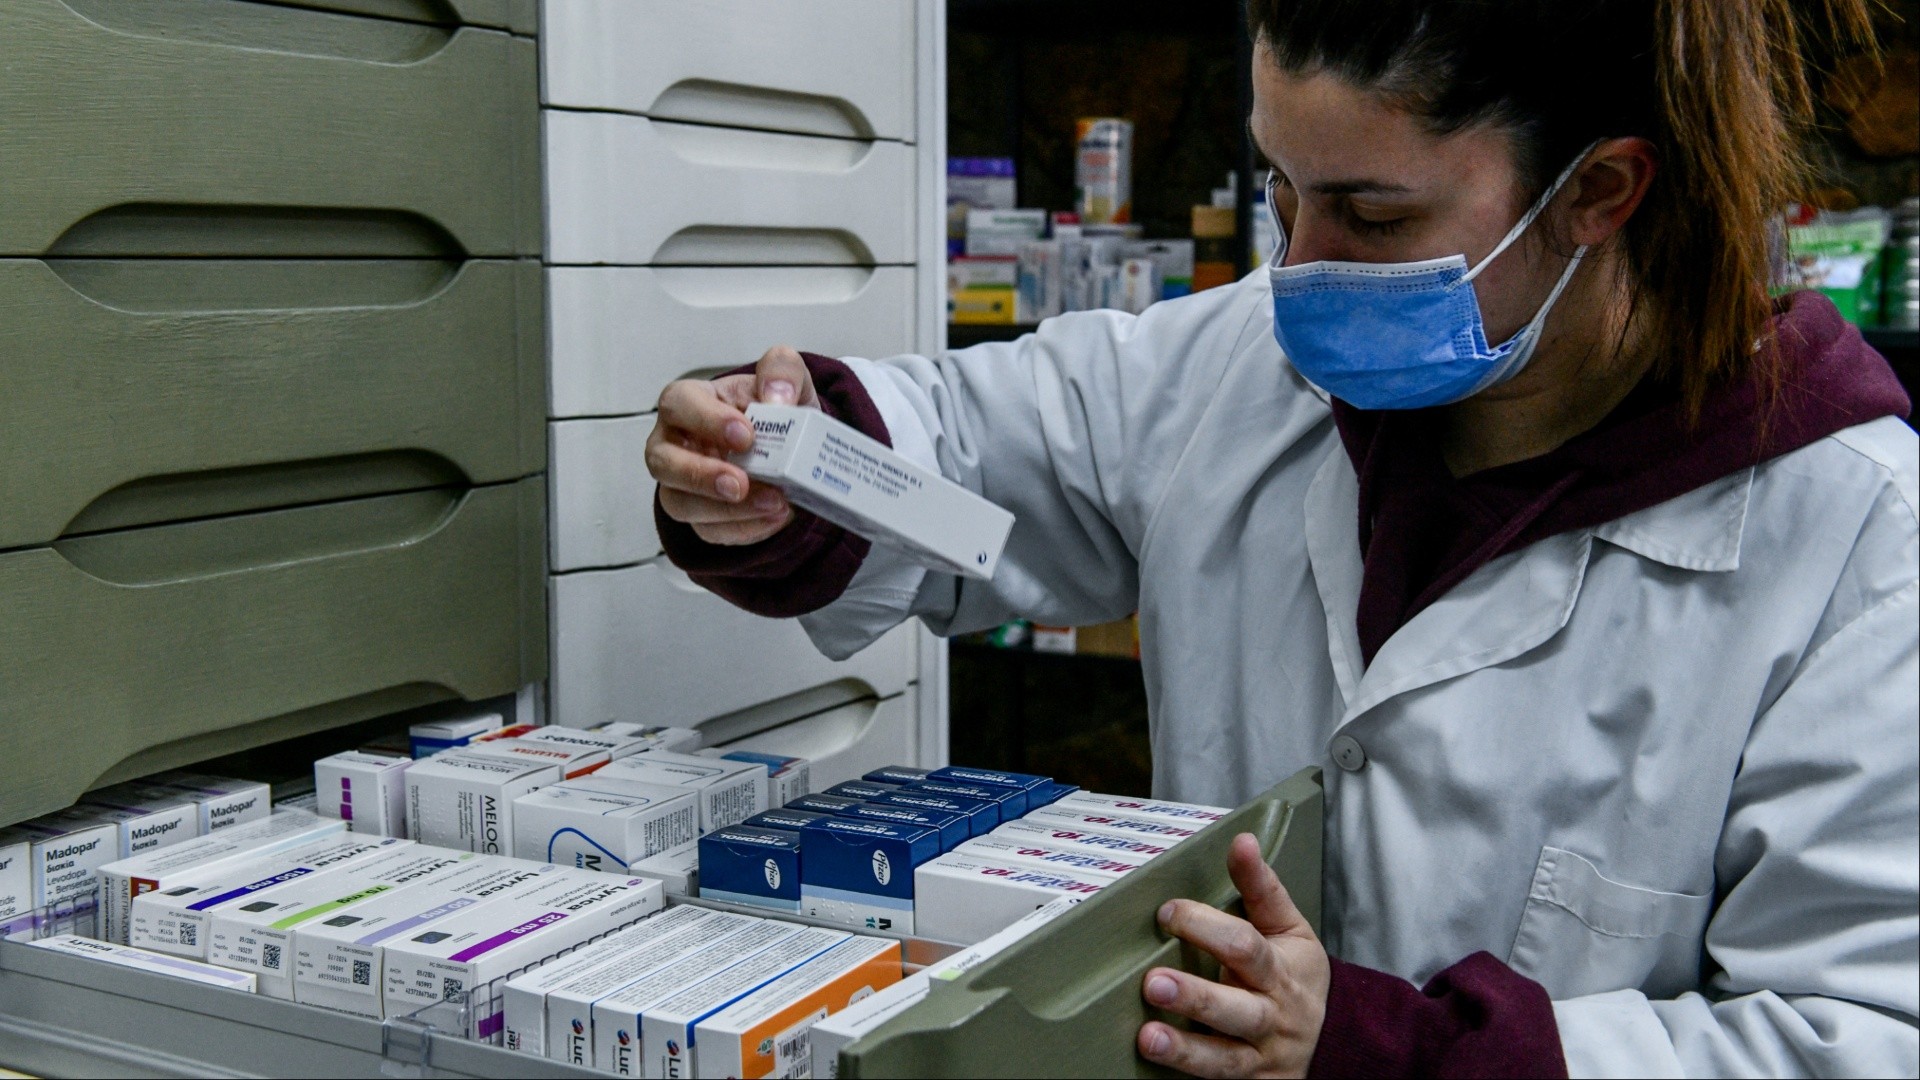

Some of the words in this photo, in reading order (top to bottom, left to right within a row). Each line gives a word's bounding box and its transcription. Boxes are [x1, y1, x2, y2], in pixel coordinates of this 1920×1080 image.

[841, 788, 882, 796] EDROL
[922, 785, 980, 795] MEDROL
[210, 798, 252, 818] Madopar
[804, 801, 847, 810] EDROL
[890, 796, 948, 808] MEDROL
[858, 809, 918, 821] MEDROL
[1084, 816, 1115, 824] 10
[762, 817, 805, 826] EDROL
[132, 820, 179, 840] Madopar
[826, 822, 887, 834] MEDROL
[720, 834, 774, 846] MEDROL
[1052, 832, 1085, 840] 10
[46, 840, 97, 861] Madopar
[316, 844, 379, 867] Lyrica
[1016, 848, 1051, 856] 10
[396, 859, 458, 883] Lyrica
[765, 860, 776, 889] Pfizer
[872, 852, 885, 885] Pfizer
[981, 868, 1016, 876] 10
[47, 868, 86, 886] Levodopa
[244, 879, 269, 892] mg
[477, 871, 540, 897] Lyrica
[336, 893, 360, 904] mg
[566, 885, 628, 911] Lyrica
[418, 906, 446, 920] mg
[538, 912, 562, 924] 25
[510, 922, 538, 934] mg
